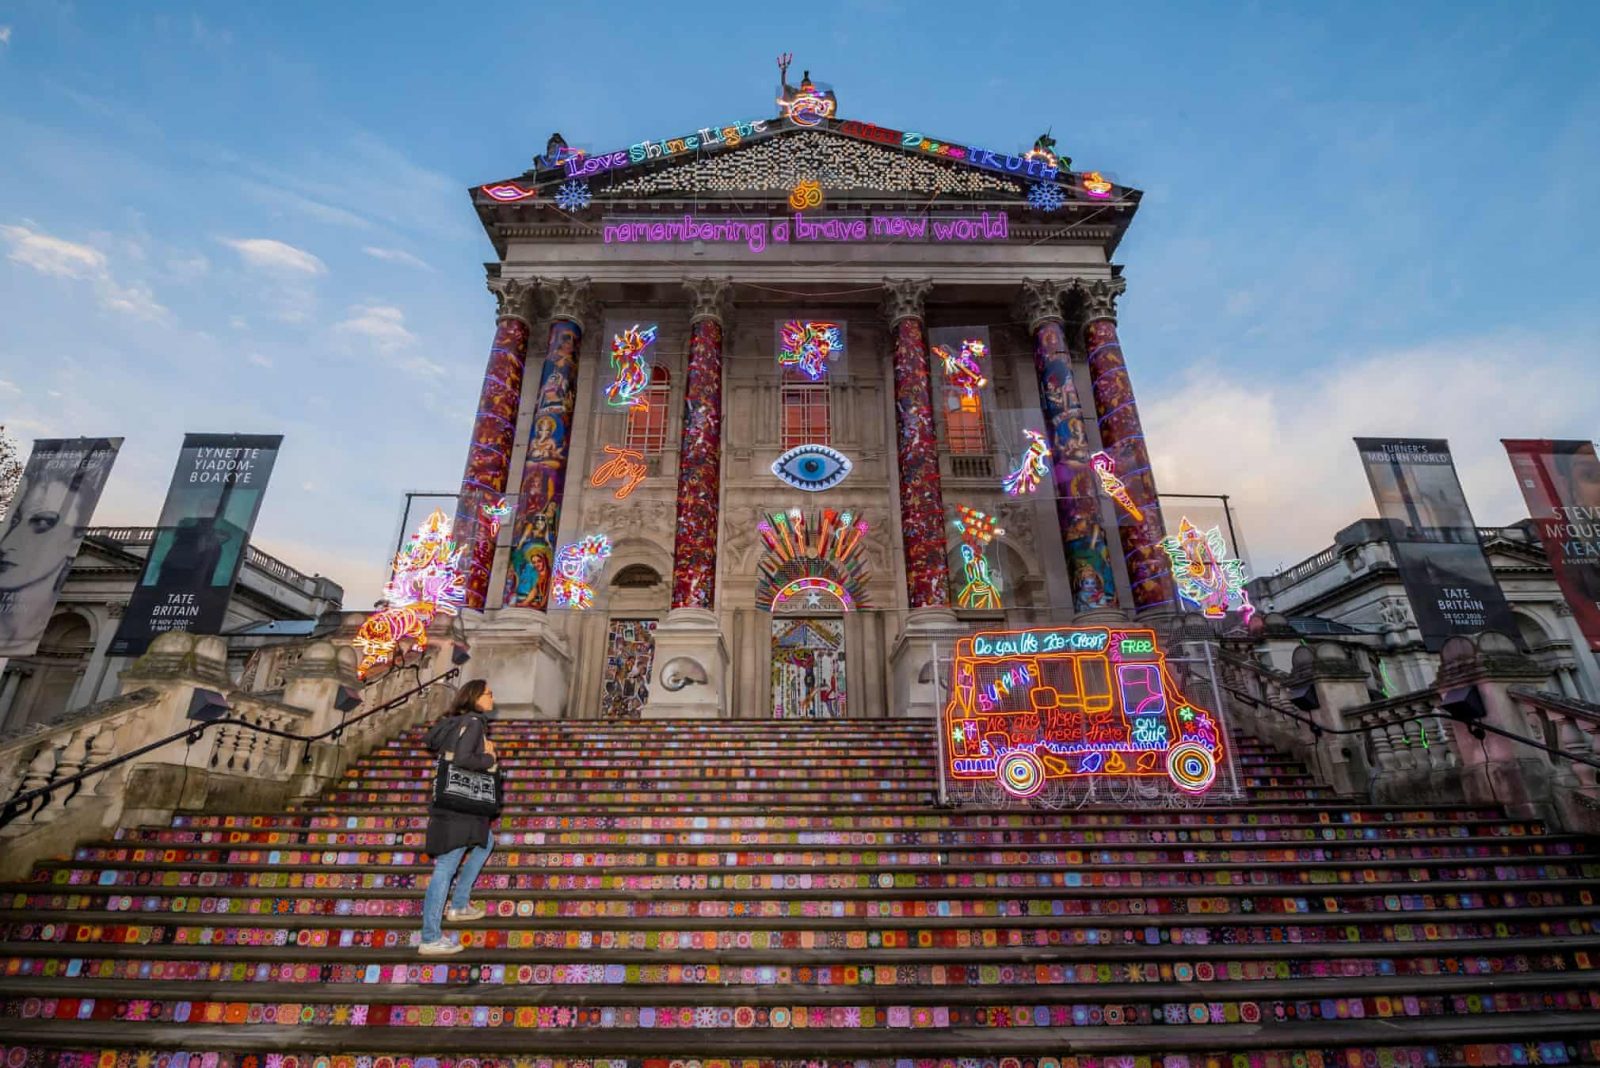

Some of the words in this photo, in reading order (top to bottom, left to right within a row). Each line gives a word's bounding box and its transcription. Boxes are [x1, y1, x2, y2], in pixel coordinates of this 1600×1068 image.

[564, 151, 628, 177] Love
[629, 136, 699, 163] Shine
[698, 119, 768, 146] Light
[967, 146, 1059, 179] TRUTH
[603, 214, 767, 253] remembering
[772, 221, 790, 242] a
[795, 211, 867, 241] brave
[871, 214, 928, 238] new
[932, 211, 1009, 241] world
[196, 447, 261, 459] LYNETTE
[1412, 452, 1448, 463] WORLD
[193, 459, 255, 471] YIADOM-
[189, 471, 252, 483] BOAKYE
[1559, 541, 1600, 556] YEA
[167, 593, 196, 604] TATE
[1442, 588, 1471, 599] TATE
[152, 605, 200, 616] BRITAIN
[1437, 600, 1484, 610] BRITAIN
[975, 637, 993, 655] Do
